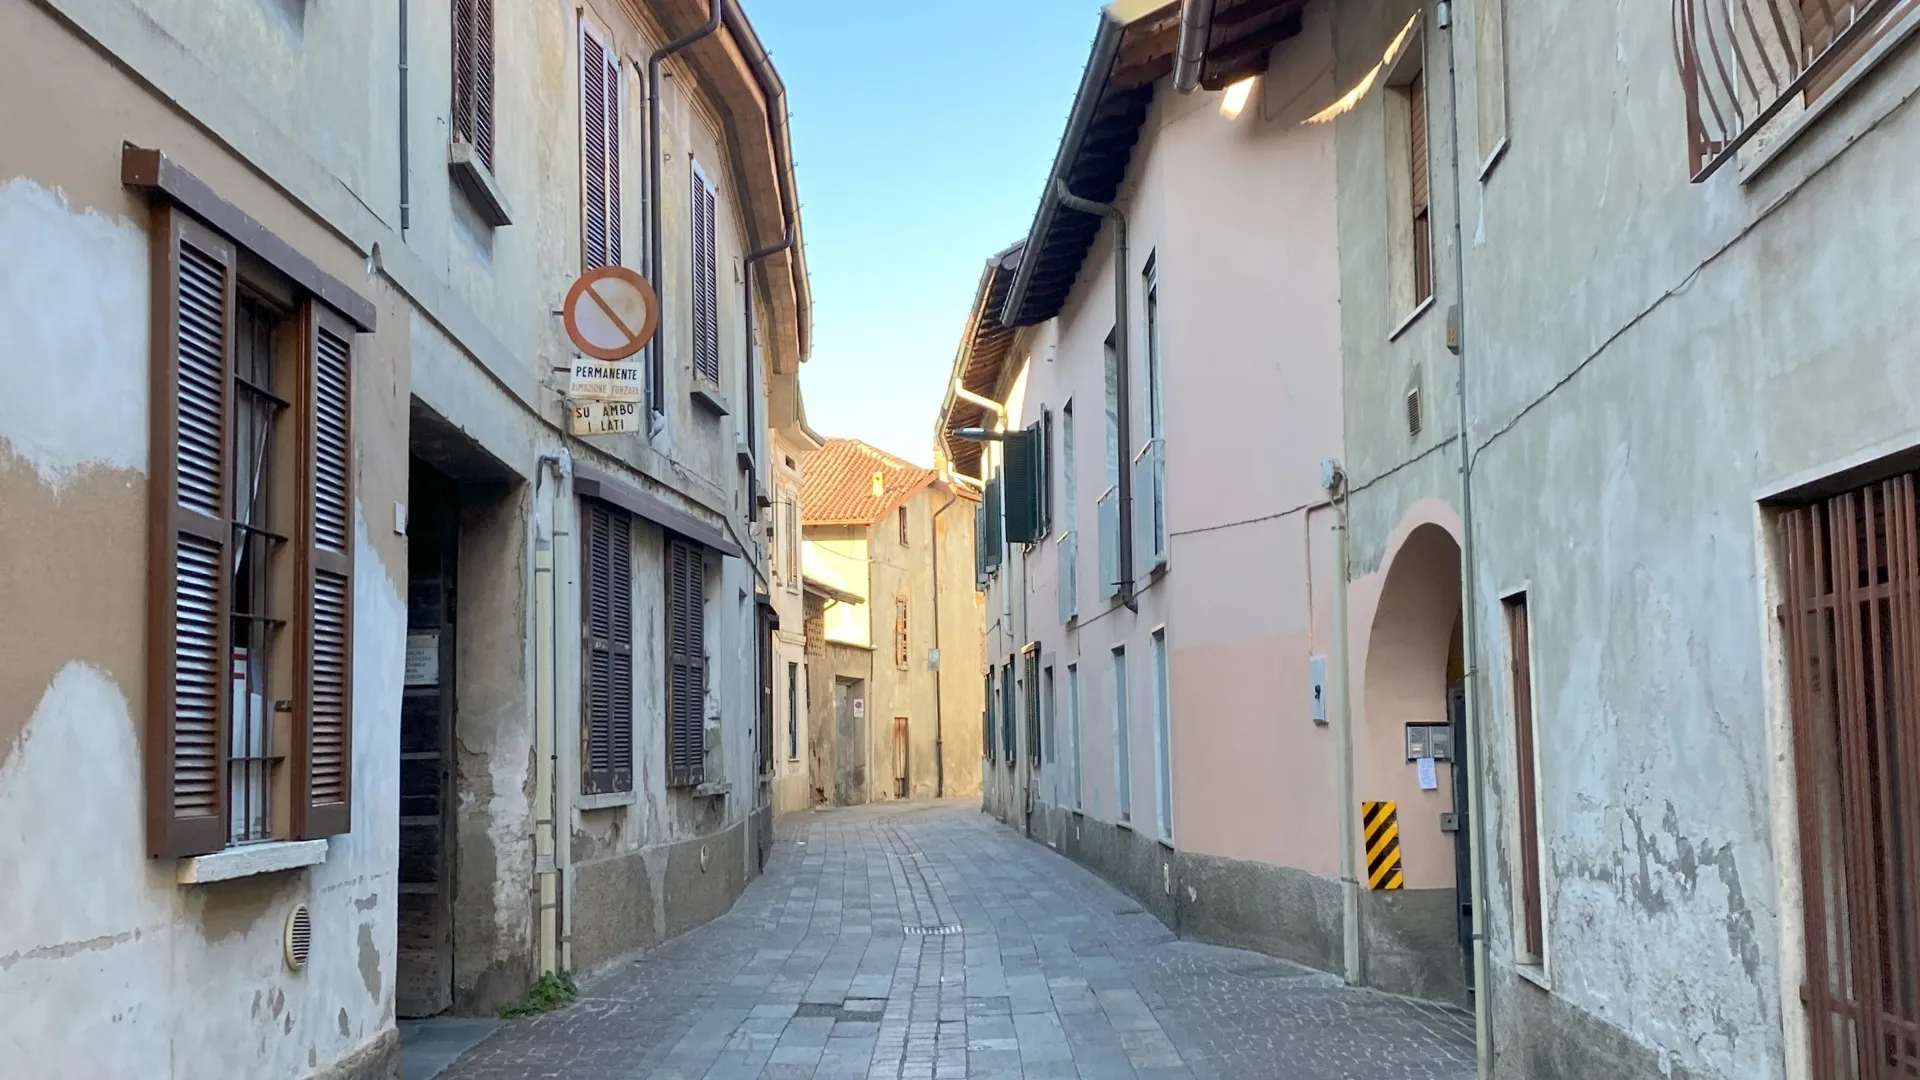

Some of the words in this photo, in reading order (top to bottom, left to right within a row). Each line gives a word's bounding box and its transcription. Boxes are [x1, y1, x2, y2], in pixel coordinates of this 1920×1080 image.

[576, 366, 637, 380] PERMANENTE
[612, 385, 640, 396] FORZATA
[576, 407, 590, 418] SU
[603, 404, 634, 417] AMBO
[601, 419, 624, 431] LATI
